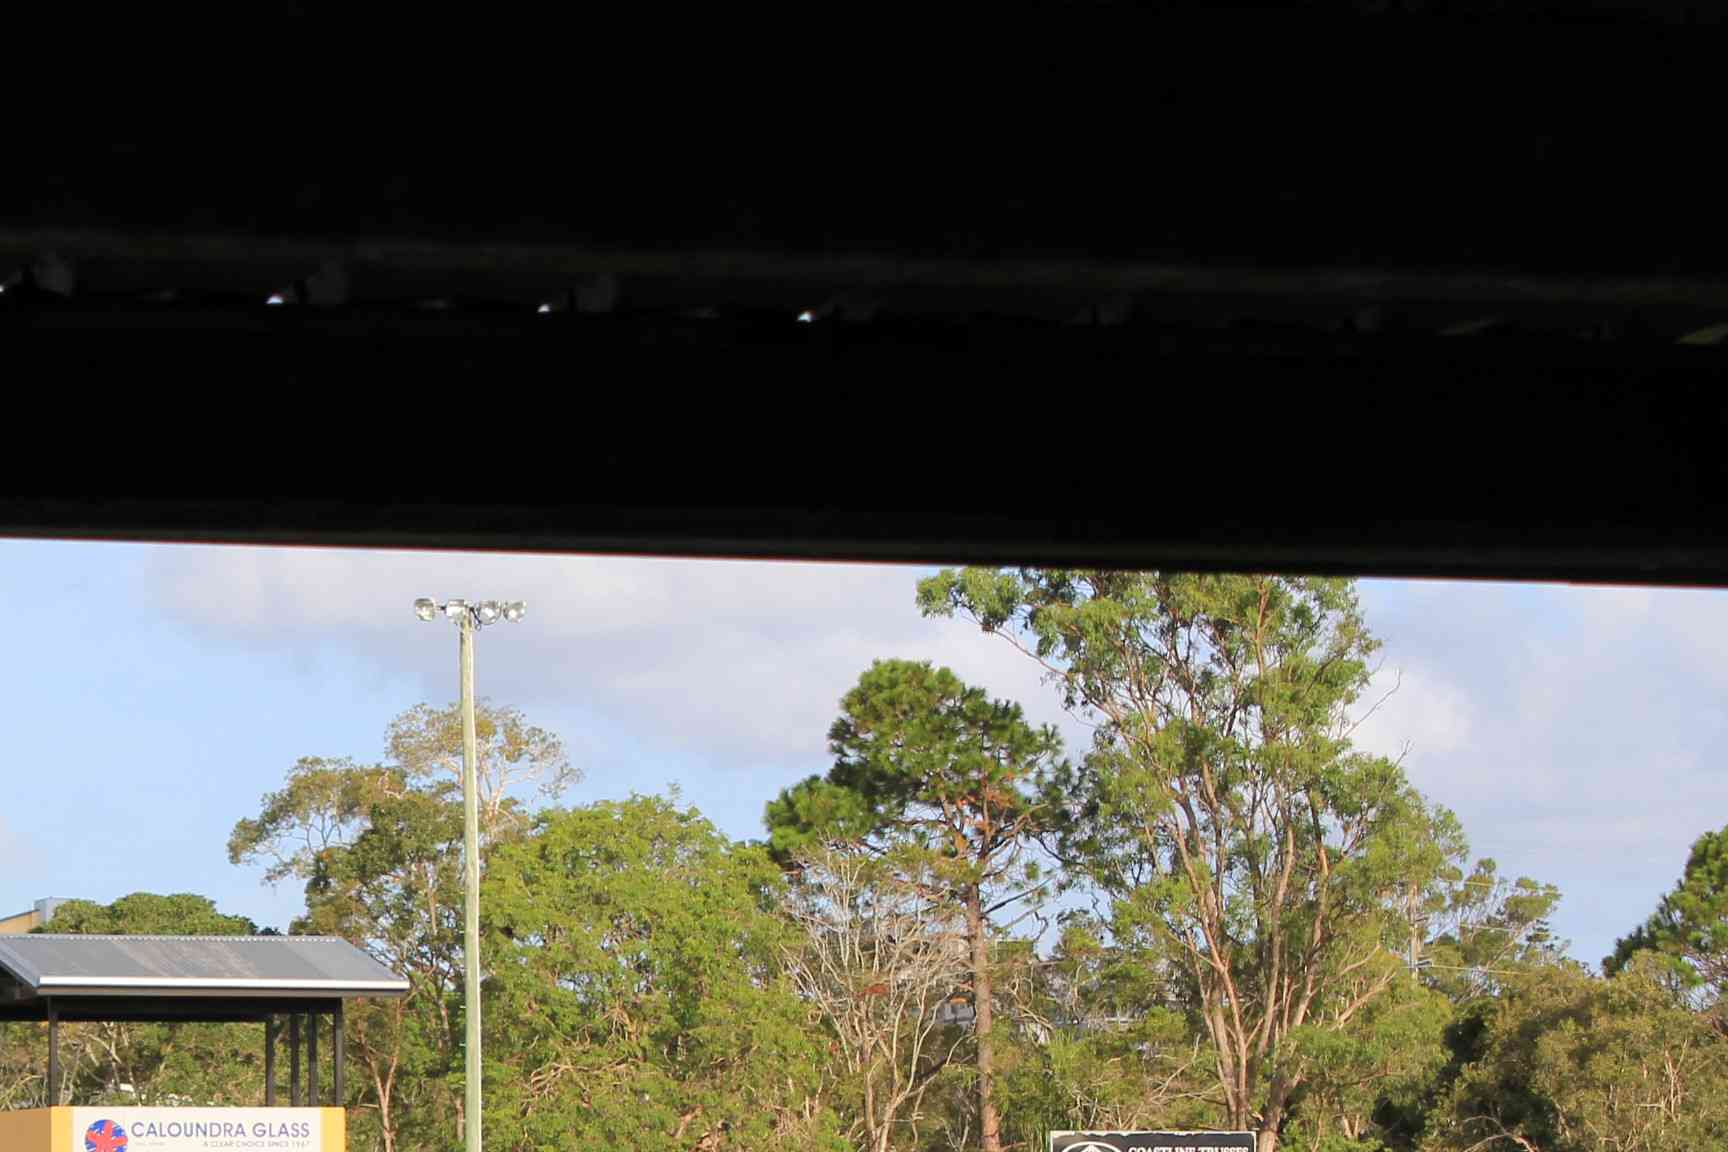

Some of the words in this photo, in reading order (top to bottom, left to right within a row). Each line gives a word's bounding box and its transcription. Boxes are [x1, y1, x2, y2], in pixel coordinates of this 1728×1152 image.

[131, 1121, 246, 1138] CALOUNDRA
[252, 1121, 310, 1138] GLASS
[210, 1140, 234, 1148] CLEAR
